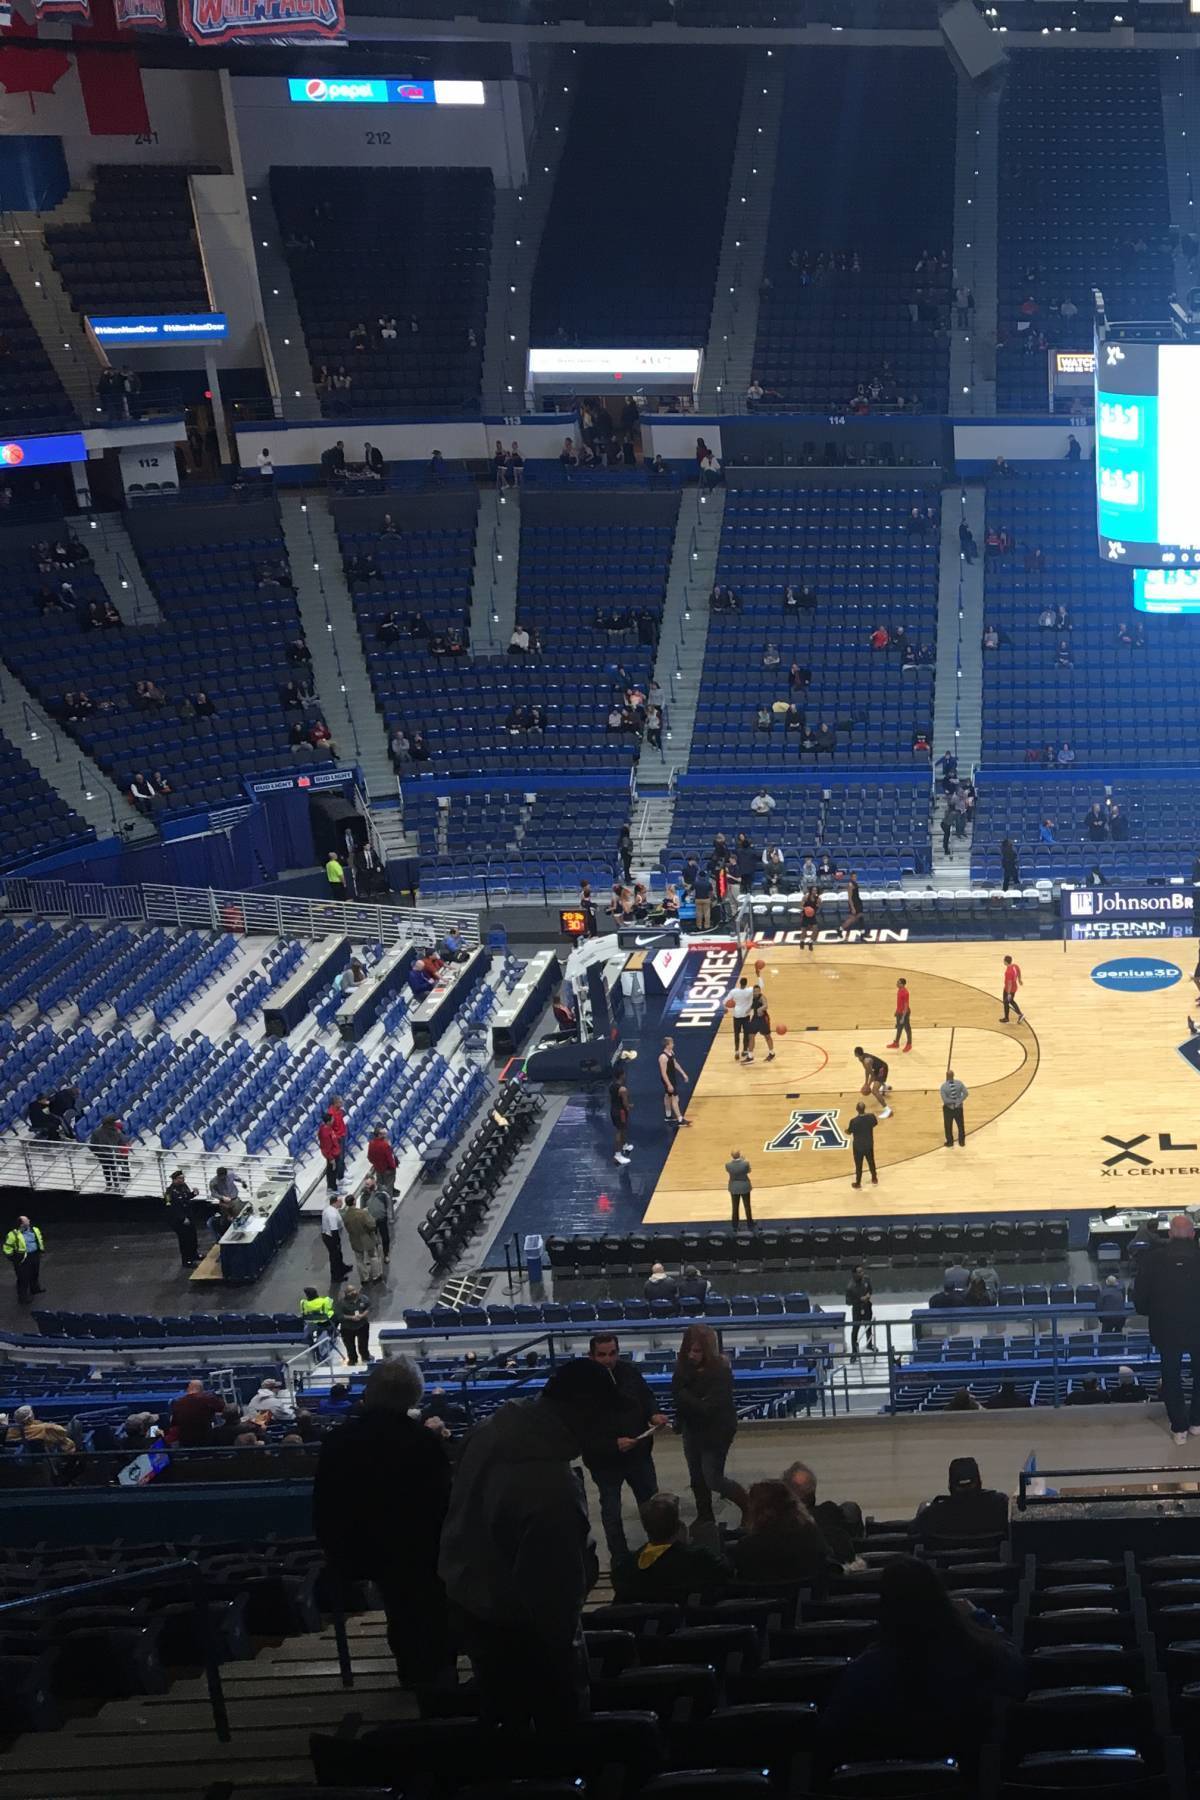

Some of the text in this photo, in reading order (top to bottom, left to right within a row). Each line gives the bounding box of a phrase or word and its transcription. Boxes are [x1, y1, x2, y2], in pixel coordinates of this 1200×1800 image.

[329, 84, 374, 98] pepsi
[365, 132, 392, 145] 212
[828, 416, 845, 425] 114
[138, 457, 160, 468] 112
[567, 920, 581, 931] 30
[1074, 922, 1166, 931] UCONN
[1091, 969, 1179, 979] genius3D
[1100, 1133, 1198, 1167] XL
[1100, 1167, 1200, 1177] XL CENTER
